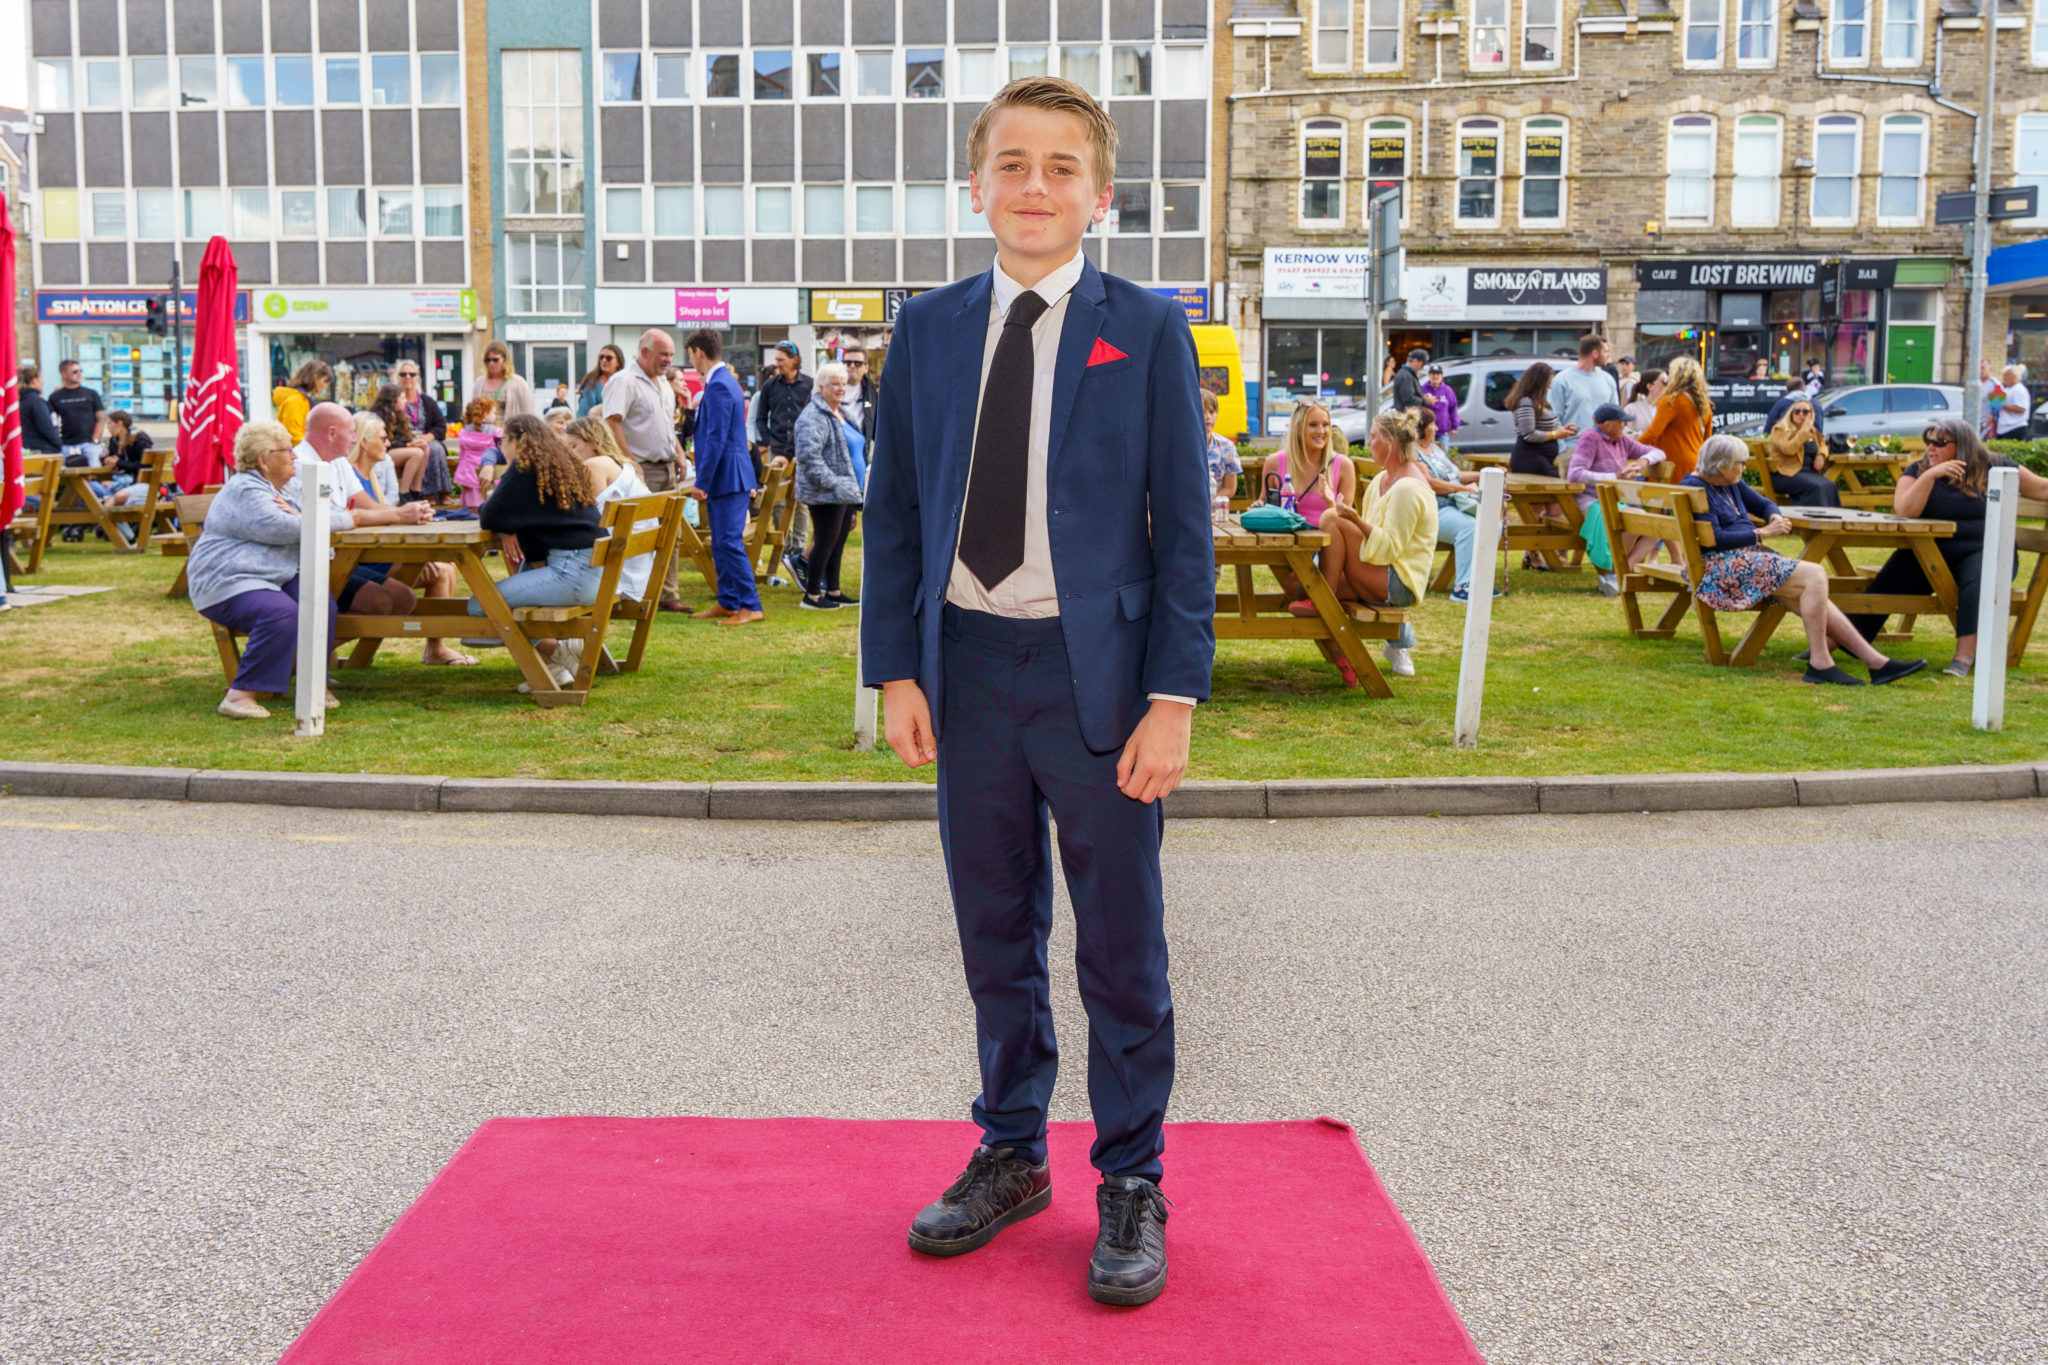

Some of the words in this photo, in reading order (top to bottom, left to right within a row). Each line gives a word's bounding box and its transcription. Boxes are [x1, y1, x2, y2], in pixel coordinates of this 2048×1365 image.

[1274, 254, 1340, 264] KERNOW
[1345, 254, 1368, 264] VIS
[1652, 270, 1677, 280] CAFE
[1690, 265, 1733, 284] LOST
[1736, 265, 1816, 284] BREWING
[1857, 269, 1878, 280] BAR
[1473, 272, 1524, 289] SMOKE
[1543, 273, 1601, 301] FLAMES
[52, 298, 126, 314] STRATTON
[128, 301, 185, 314] CRER
[292, 300, 328, 311] OXFAM
[679, 306, 702, 318] Shop
[702, 307, 712, 316] to
[712, 306, 725, 316] let
[1712, 414, 1725, 427] ST
[1727, 412, 1768, 425] BREW
